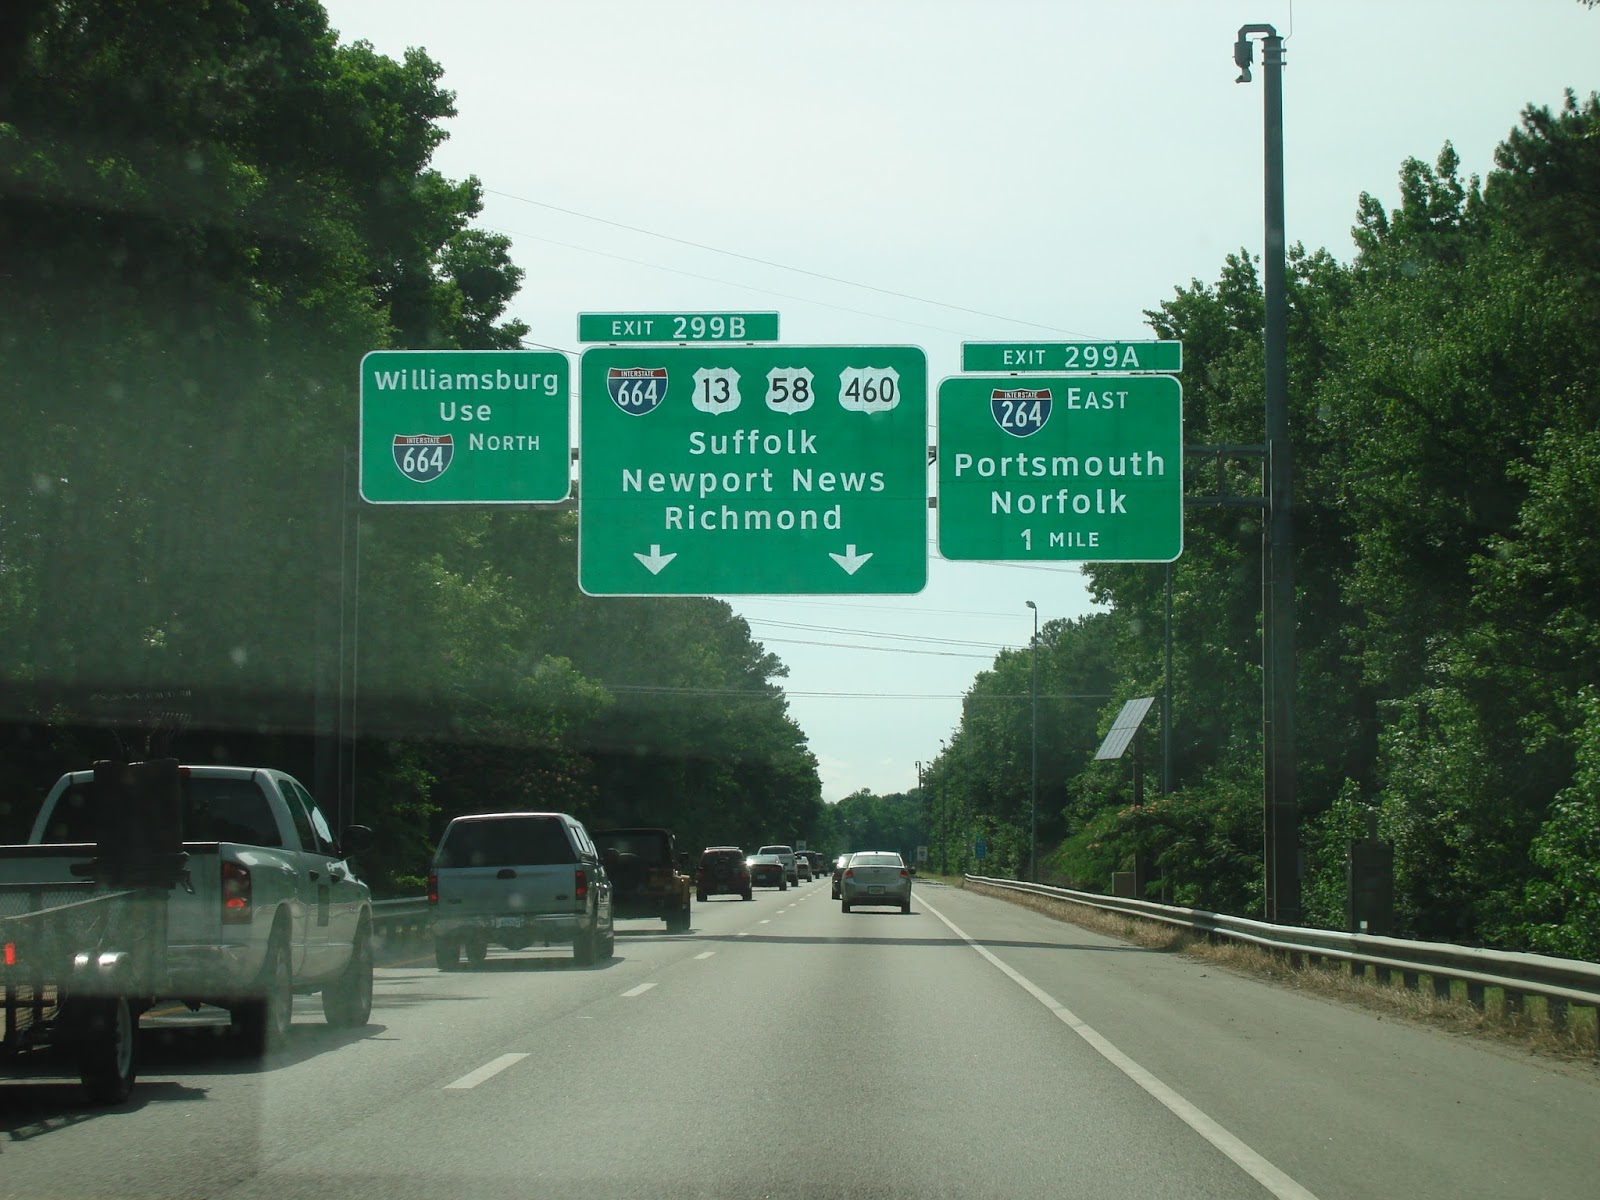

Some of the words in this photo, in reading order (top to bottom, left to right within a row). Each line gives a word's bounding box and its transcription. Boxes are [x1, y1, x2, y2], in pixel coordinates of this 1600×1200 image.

[611, 320, 654, 336] EXIT
[672, 316, 746, 339] 299B
[1004, 350, 1045, 364] EXIT
[1064, 345, 1140, 368] 299A
[375, 369, 557, 395] Williamsburg
[618, 379, 657, 406] 664
[704, 378, 729, 403] 13
[771, 376, 809, 403] 58
[844, 376, 895, 403] 460
[1004, 391, 1038, 399] INTERSTATE
[1068, 388, 1128, 409] EAST
[441, 402, 491, 421] Use
[1001, 400, 1042, 428] 264
[470, 434, 539, 450] NORTH
[690, 430, 817, 454] Suffolk
[403, 446, 443, 473] 664
[956, 451, 1163, 476] Portsmouth
[623, 469, 772, 498] Newport
[793, 469, 884, 491] News
[992, 489, 1126, 513] Norfolk
[666, 505, 840, 529] Richmond
[1021, 529, 1030, 550] 1
[1050, 532, 1098, 546] MILE
